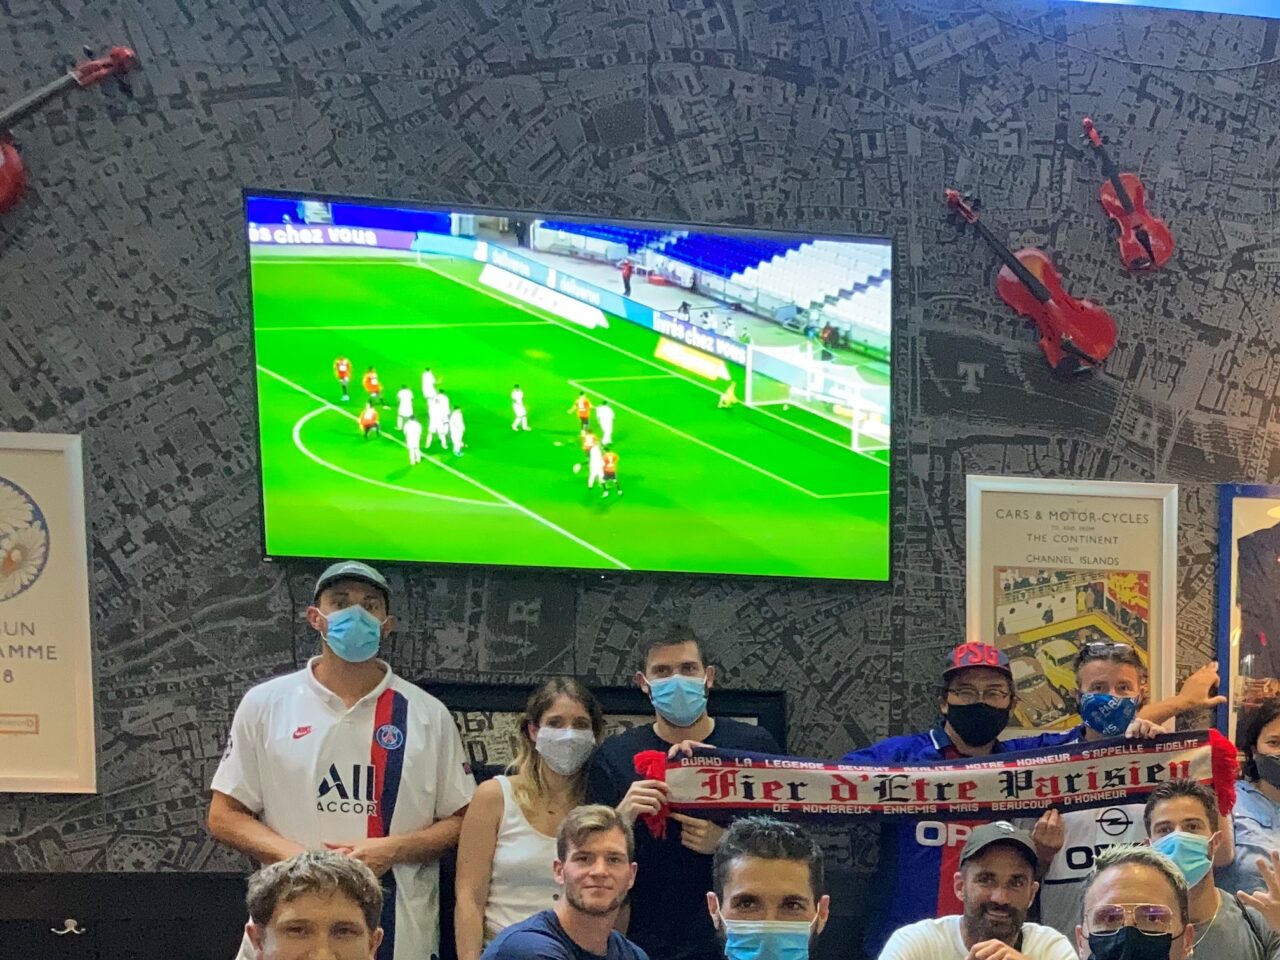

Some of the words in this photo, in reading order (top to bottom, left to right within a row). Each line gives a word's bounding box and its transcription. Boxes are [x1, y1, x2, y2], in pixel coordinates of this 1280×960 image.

[273, 223, 323, 244] chez
[327, 227, 377, 245] vous
[995, 508, 1029, 520] CARS
[1035, 511, 1042, 520] &
[1048, 511, 1149, 524] MOTOR-CYCLES
[1026, 533, 1047, 542] THE
[1053, 534, 1119, 544] CONTINENT
[1026, 554, 1074, 565] CHANNEL
[1080, 557, 1119, 566] ISLANDS
[953, 641, 1000, 666] PSG
[681, 757, 722, 767] QUAND
[735, 758, 752, 767] LA
[765, 759, 824, 770] LEGENDE
[1016, 753, 1070, 767] HONNEUR
[1081, 744, 1144, 760] S'APPELLE
[1155, 739, 1199, 752] FIDELITE
[695, 767, 808, 801] Fier
[998, 758, 1190, 800] Parisien
[316, 801, 377, 816] ACCOR
[772, 804, 790, 813] DE
[802, 804, 872, 815] NOMBREUX
[883, 805, 937, 815] ENNEMIS
[950, 803, 979, 813] MAIS
[991, 799, 1052, 812] BEAUCOUP
[1063, 789, 1128, 806] D'HONNEUR
[915, 821, 970, 847] OP
